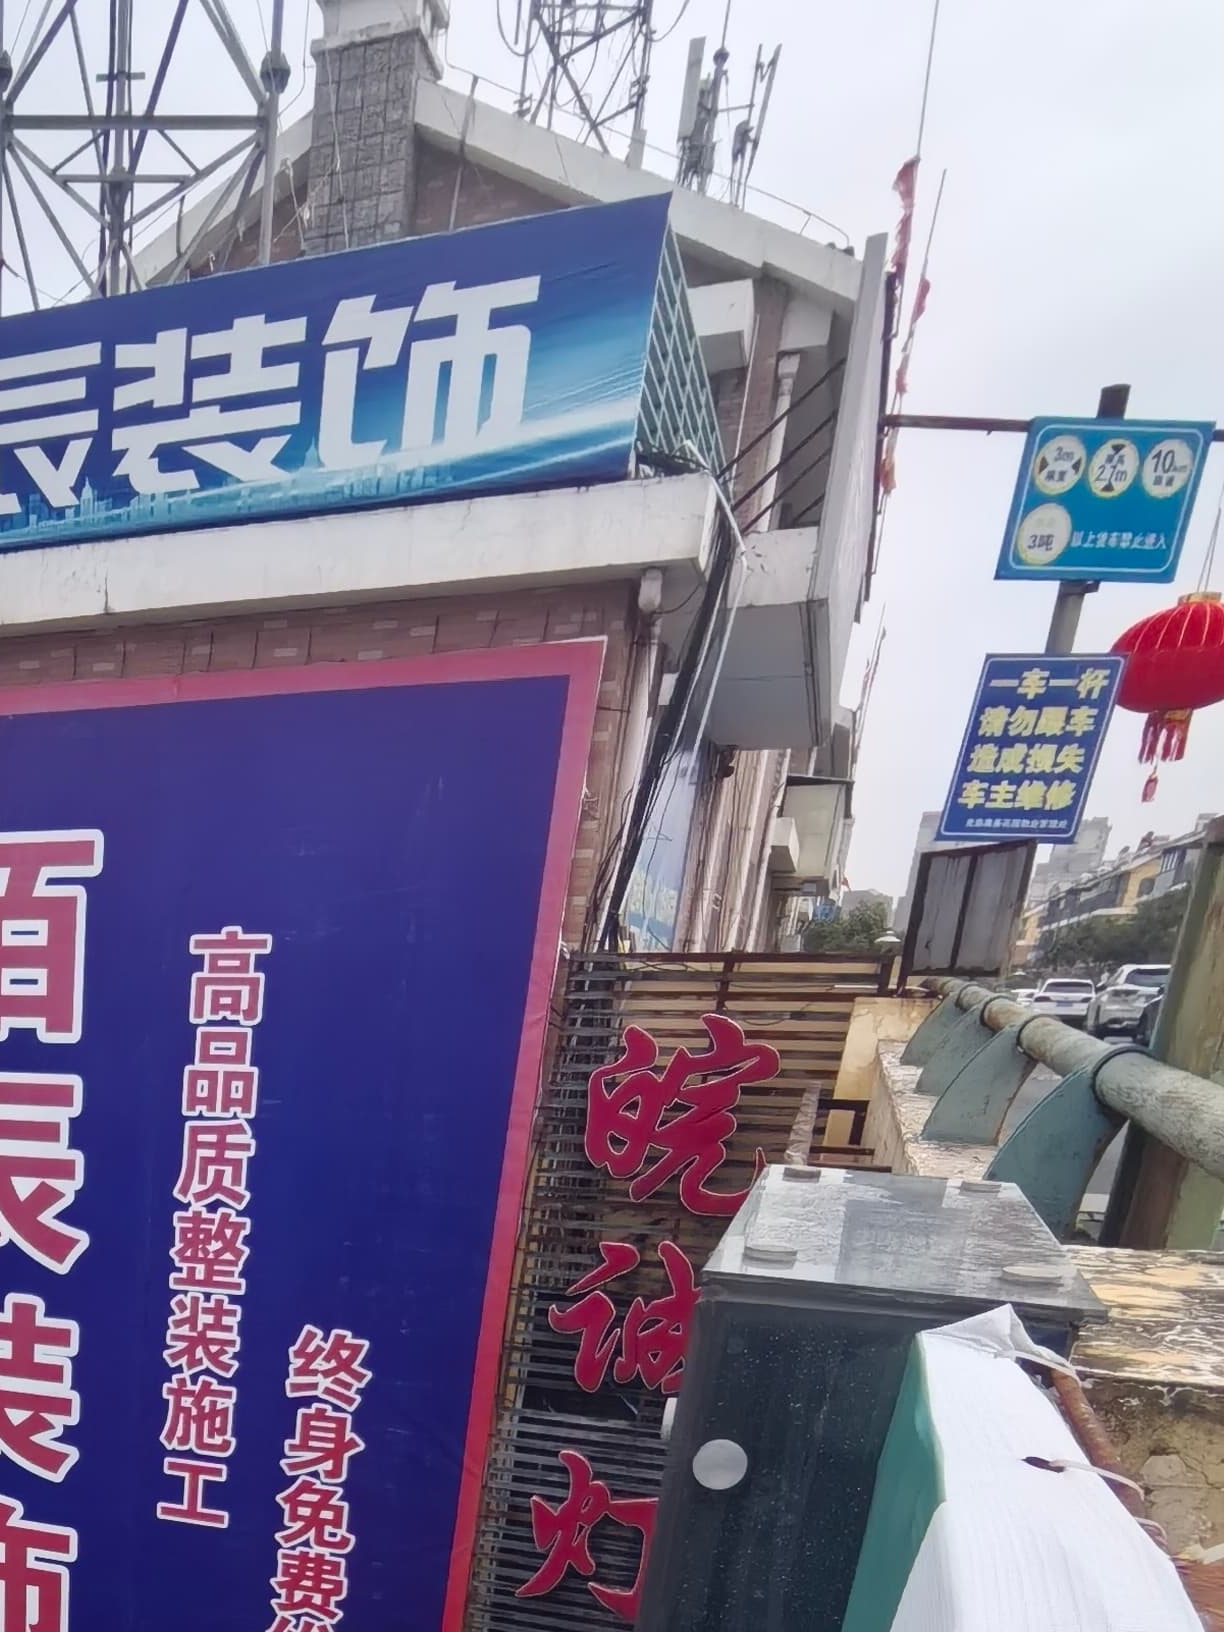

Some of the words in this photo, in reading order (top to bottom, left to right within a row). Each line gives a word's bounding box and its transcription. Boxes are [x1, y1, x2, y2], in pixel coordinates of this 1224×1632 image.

[989, 668, 1111, 700] 一车一杆
[978, 705, 1098, 736] 请勿跟车
[967, 743, 1086, 774] 造成损失
[957, 779, 1077, 811] 车主维修
[157, 926, 273, 1531] 高品质整装施工
